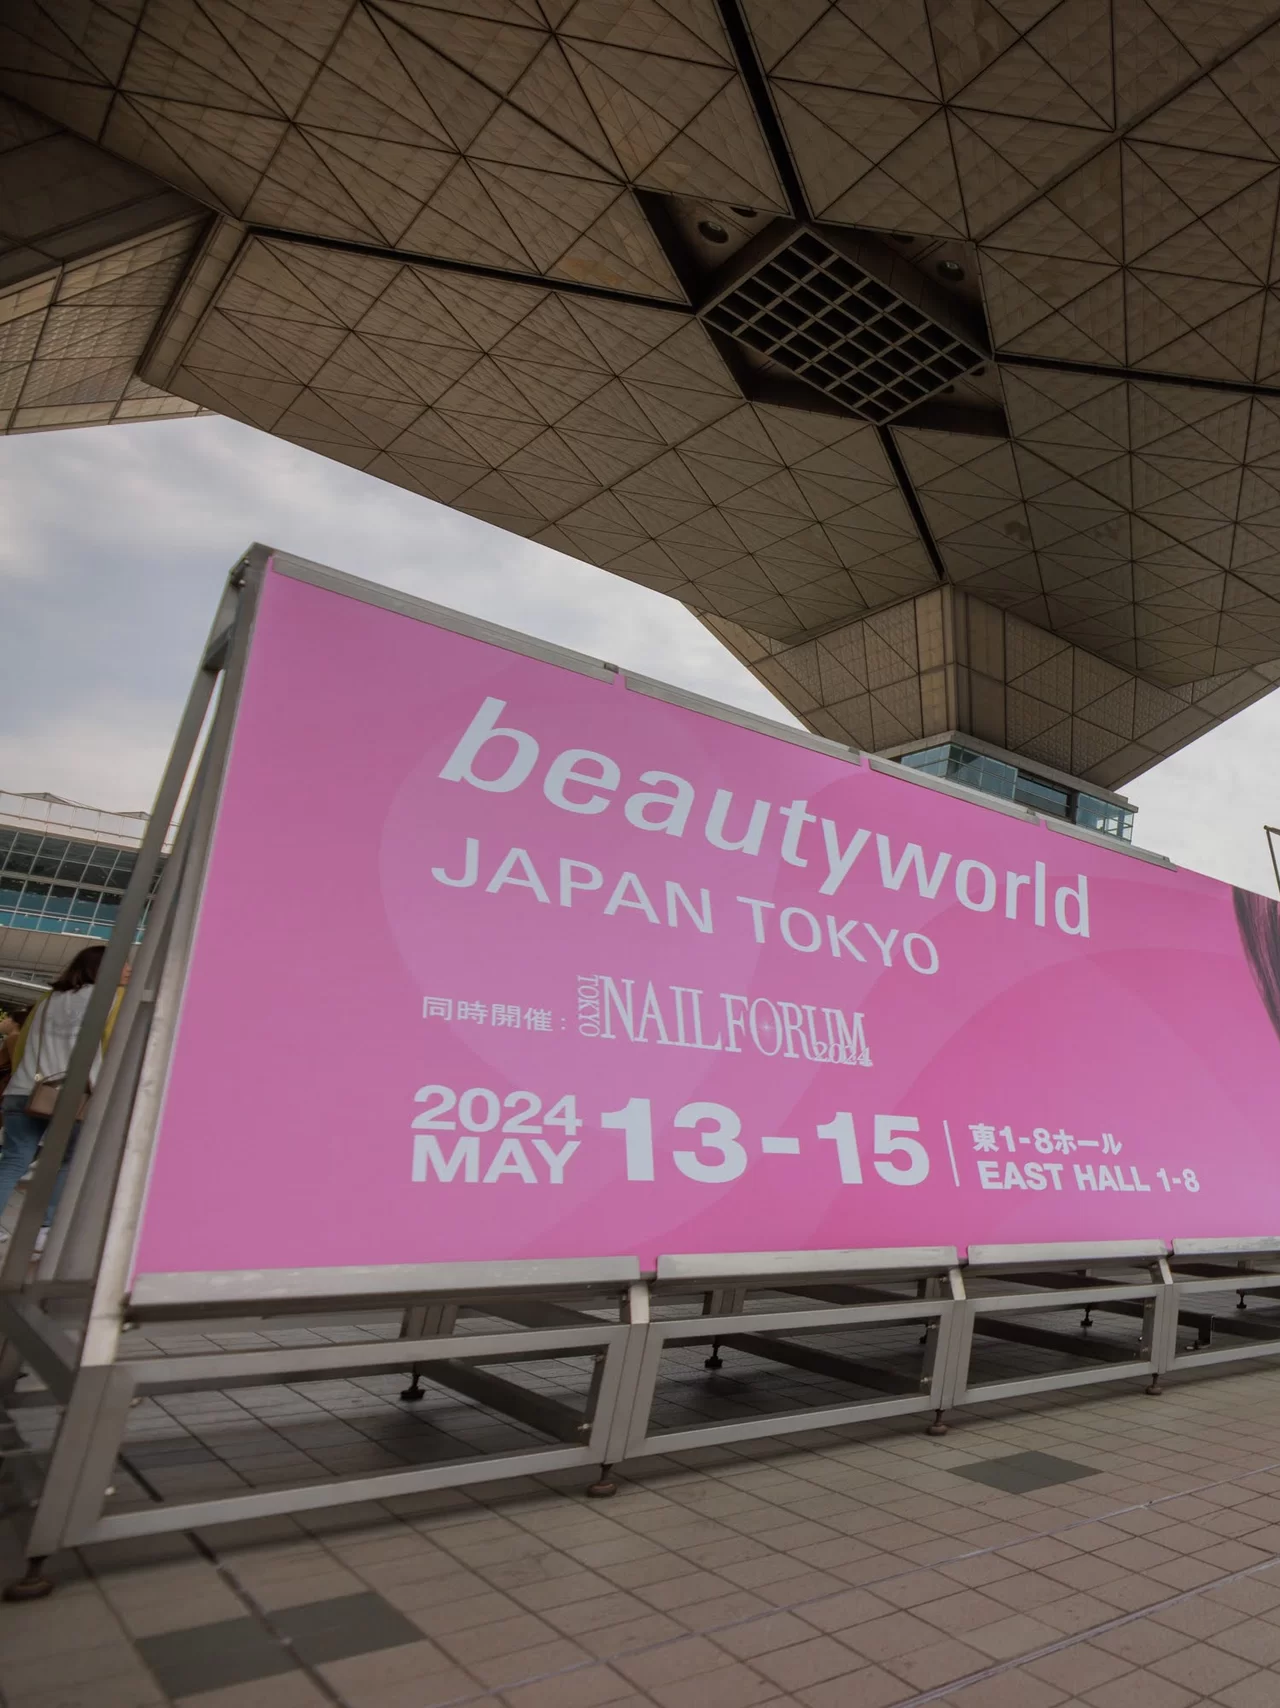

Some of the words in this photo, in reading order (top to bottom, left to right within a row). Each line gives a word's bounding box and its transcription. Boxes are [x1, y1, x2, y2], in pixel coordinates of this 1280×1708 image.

[440, 697, 1091, 938] beautyworld
[431, 836, 714, 934] JAPAN
[736, 895, 939, 975] TOKYO
[577, 974, 601, 1037] TOKYO
[599, 975, 723, 1051] NAIL
[719, 992, 873, 1067] FORUM
[814, 1041, 872, 1064] 2024
[412, 1084, 583, 1137] 2024
[411, 1134, 581, 1184] MAY
[968, 1123, 1123, 1155] 東1-8ホール
[977, 1160, 1064, 1191] EAST
[1073, 1164, 1152, 1192] HALL
[1156, 1167, 1200, 1193] 1-8
